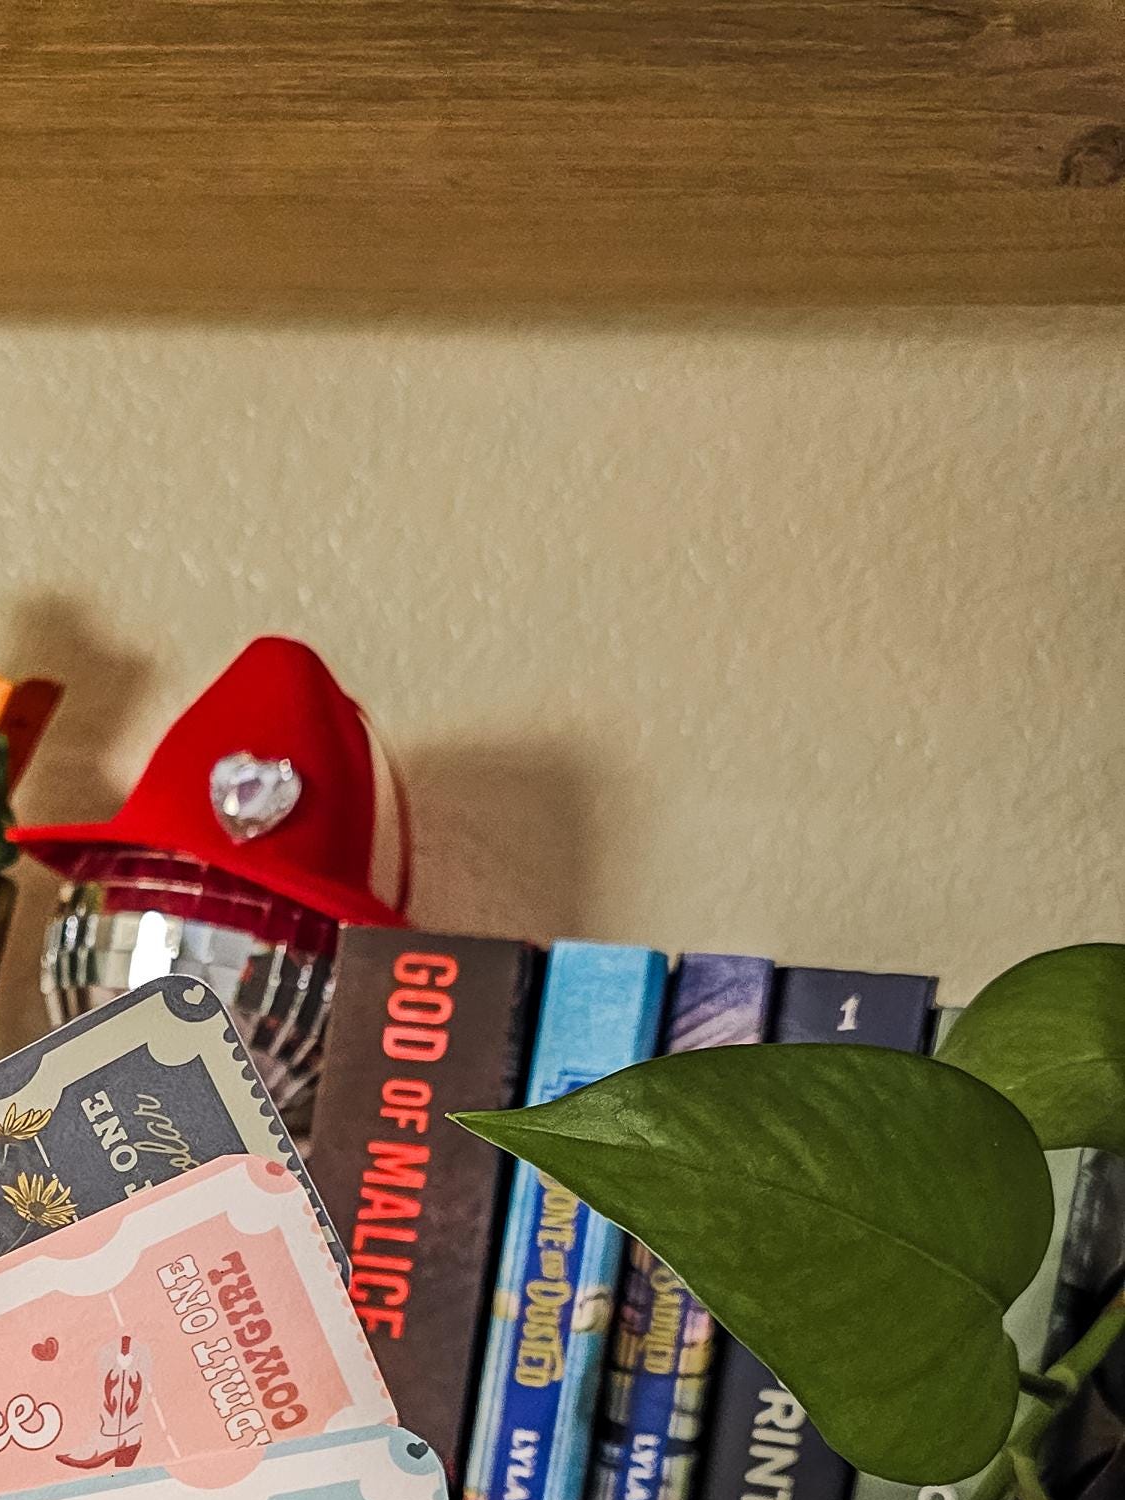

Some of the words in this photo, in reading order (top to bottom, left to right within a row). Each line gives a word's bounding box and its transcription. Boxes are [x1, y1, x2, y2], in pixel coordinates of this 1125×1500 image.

[382, 951, 459, 1062] GOD
[837, 994, 861, 1032] 1
[80, 1090, 139, 1172] ONE
[379, 1077, 434, 1135] OF
[346, 1140, 435, 1340] MALICE
[156, 1254, 219, 1334] ONE
[207, 1251, 308, 1431] COWGIRL
